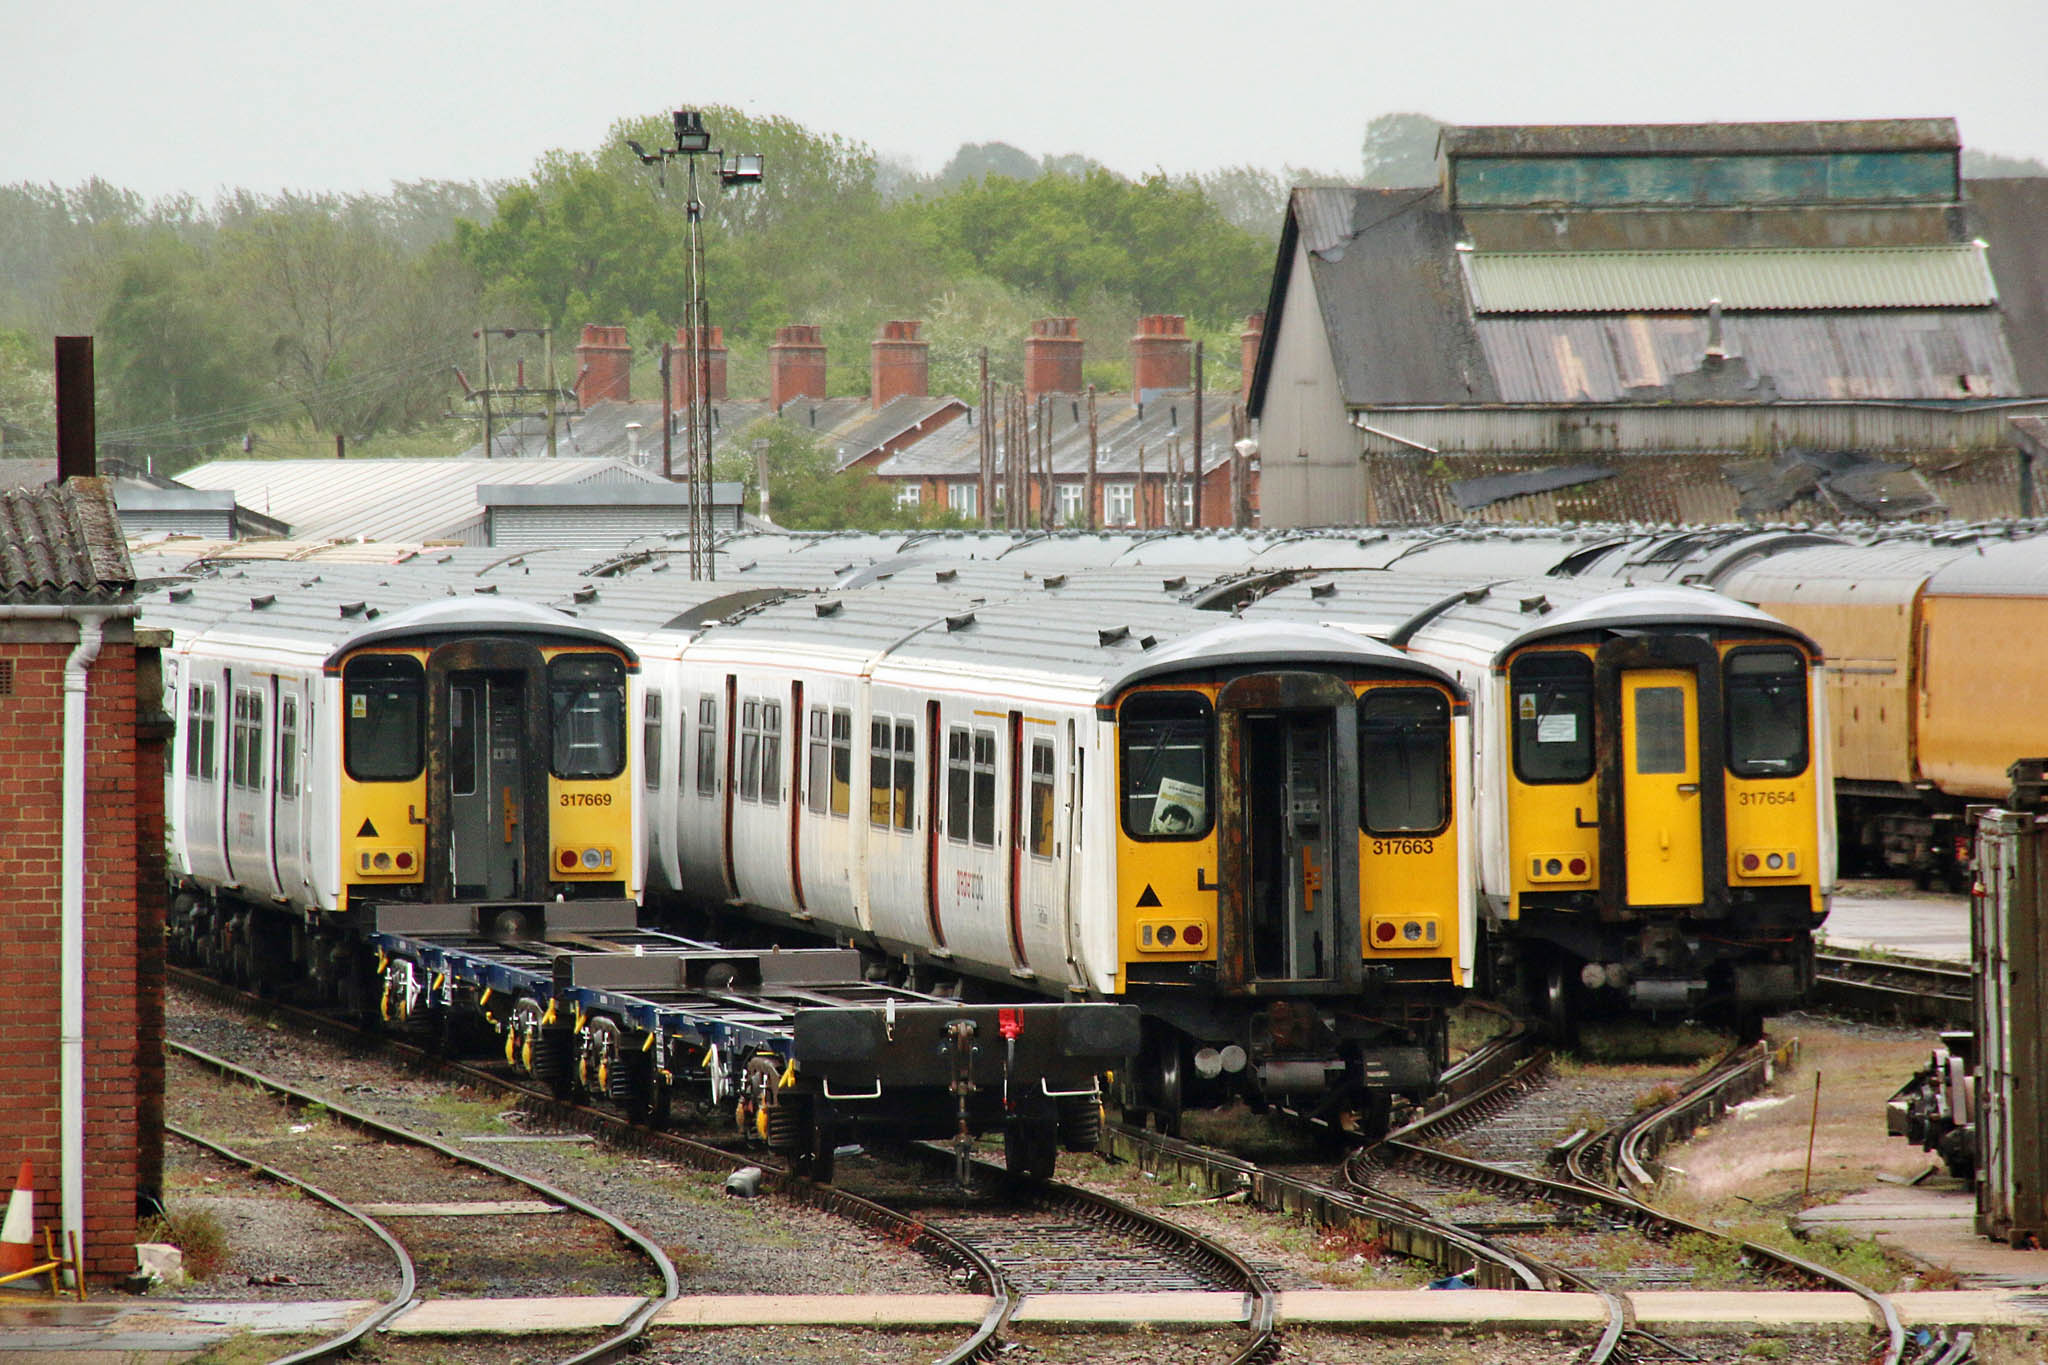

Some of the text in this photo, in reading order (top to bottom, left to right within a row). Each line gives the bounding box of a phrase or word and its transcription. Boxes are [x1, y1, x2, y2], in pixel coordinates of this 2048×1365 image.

[560, 793, 612, 806] 317669
[1739, 791, 1796, 806] 317654
[1373, 839, 1433, 855] 317663
